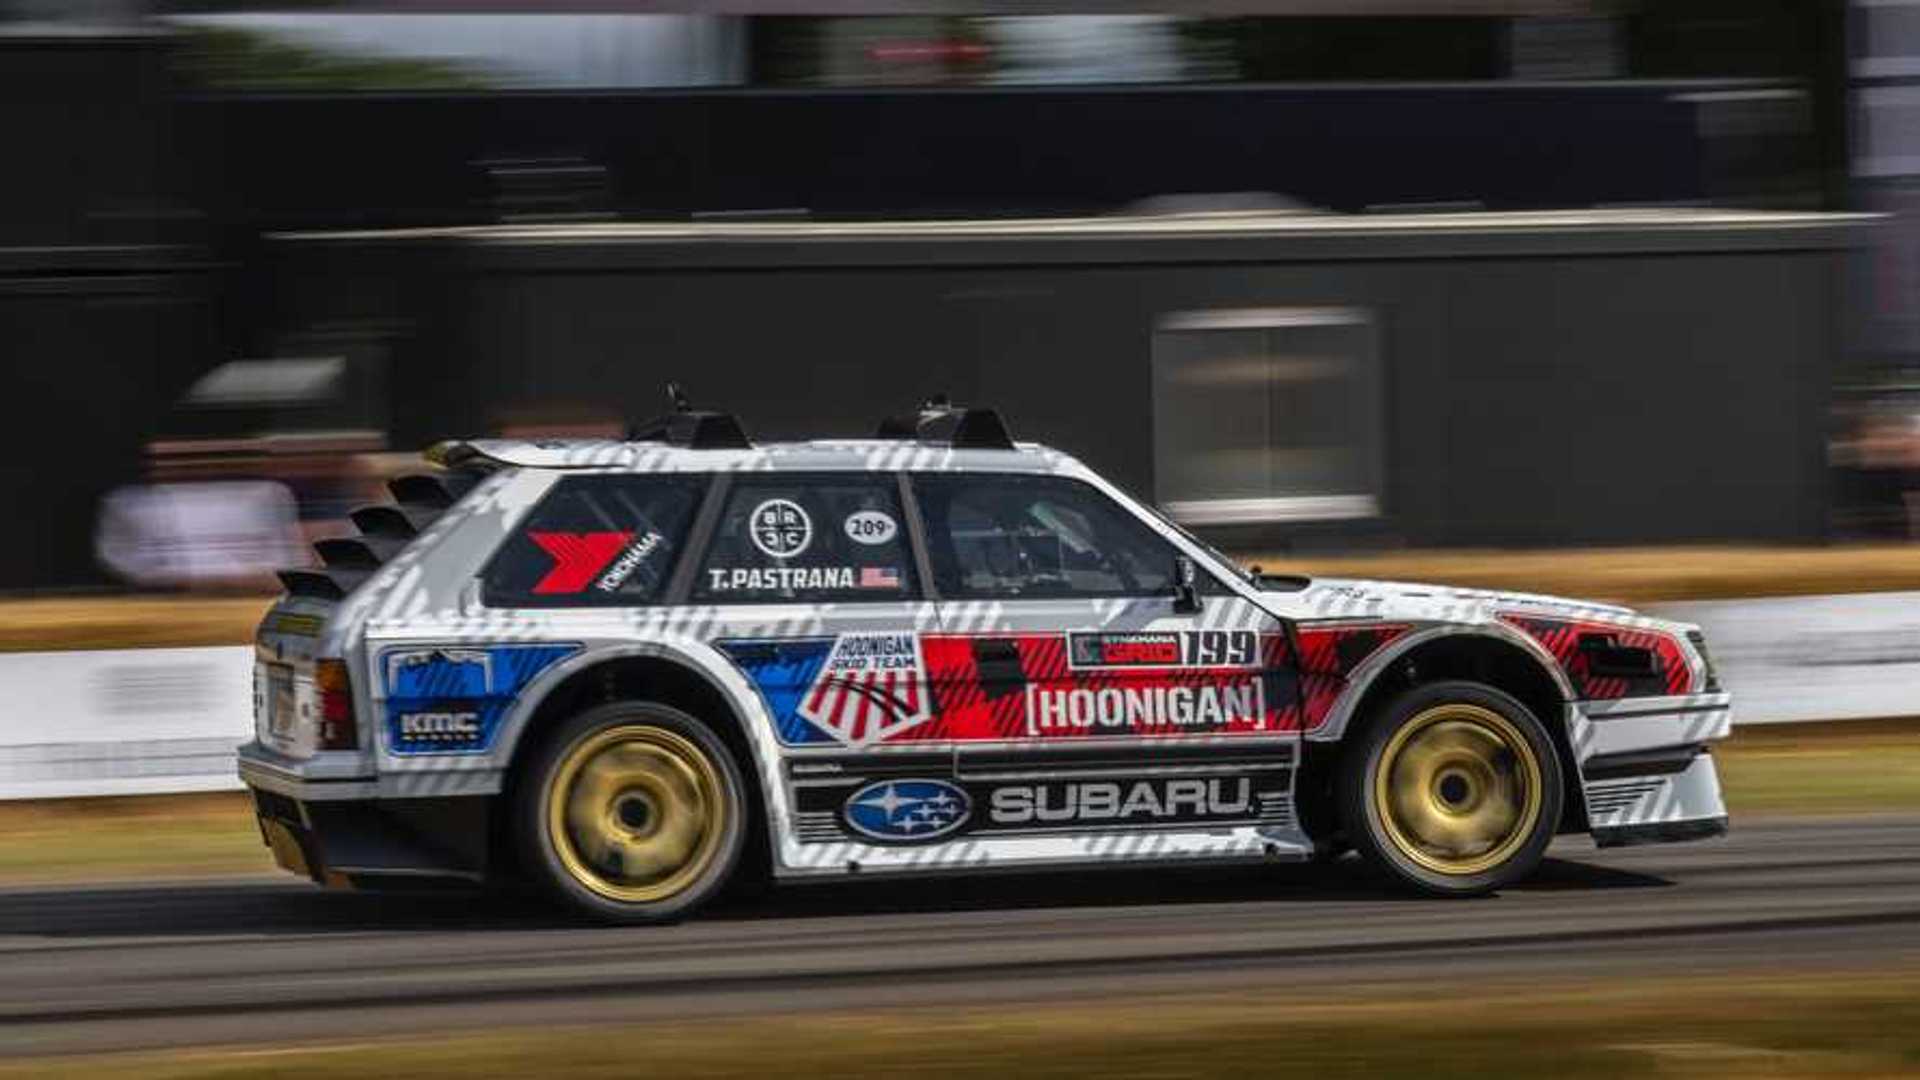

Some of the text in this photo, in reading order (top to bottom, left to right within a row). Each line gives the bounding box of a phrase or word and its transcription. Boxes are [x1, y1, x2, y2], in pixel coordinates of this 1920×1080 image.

[852, 520, 886, 536] 209
[1185, 630, 1258, 665] 199
[872, 656, 915, 668] TEAM
[990, 778, 1250, 822] SUBARU
